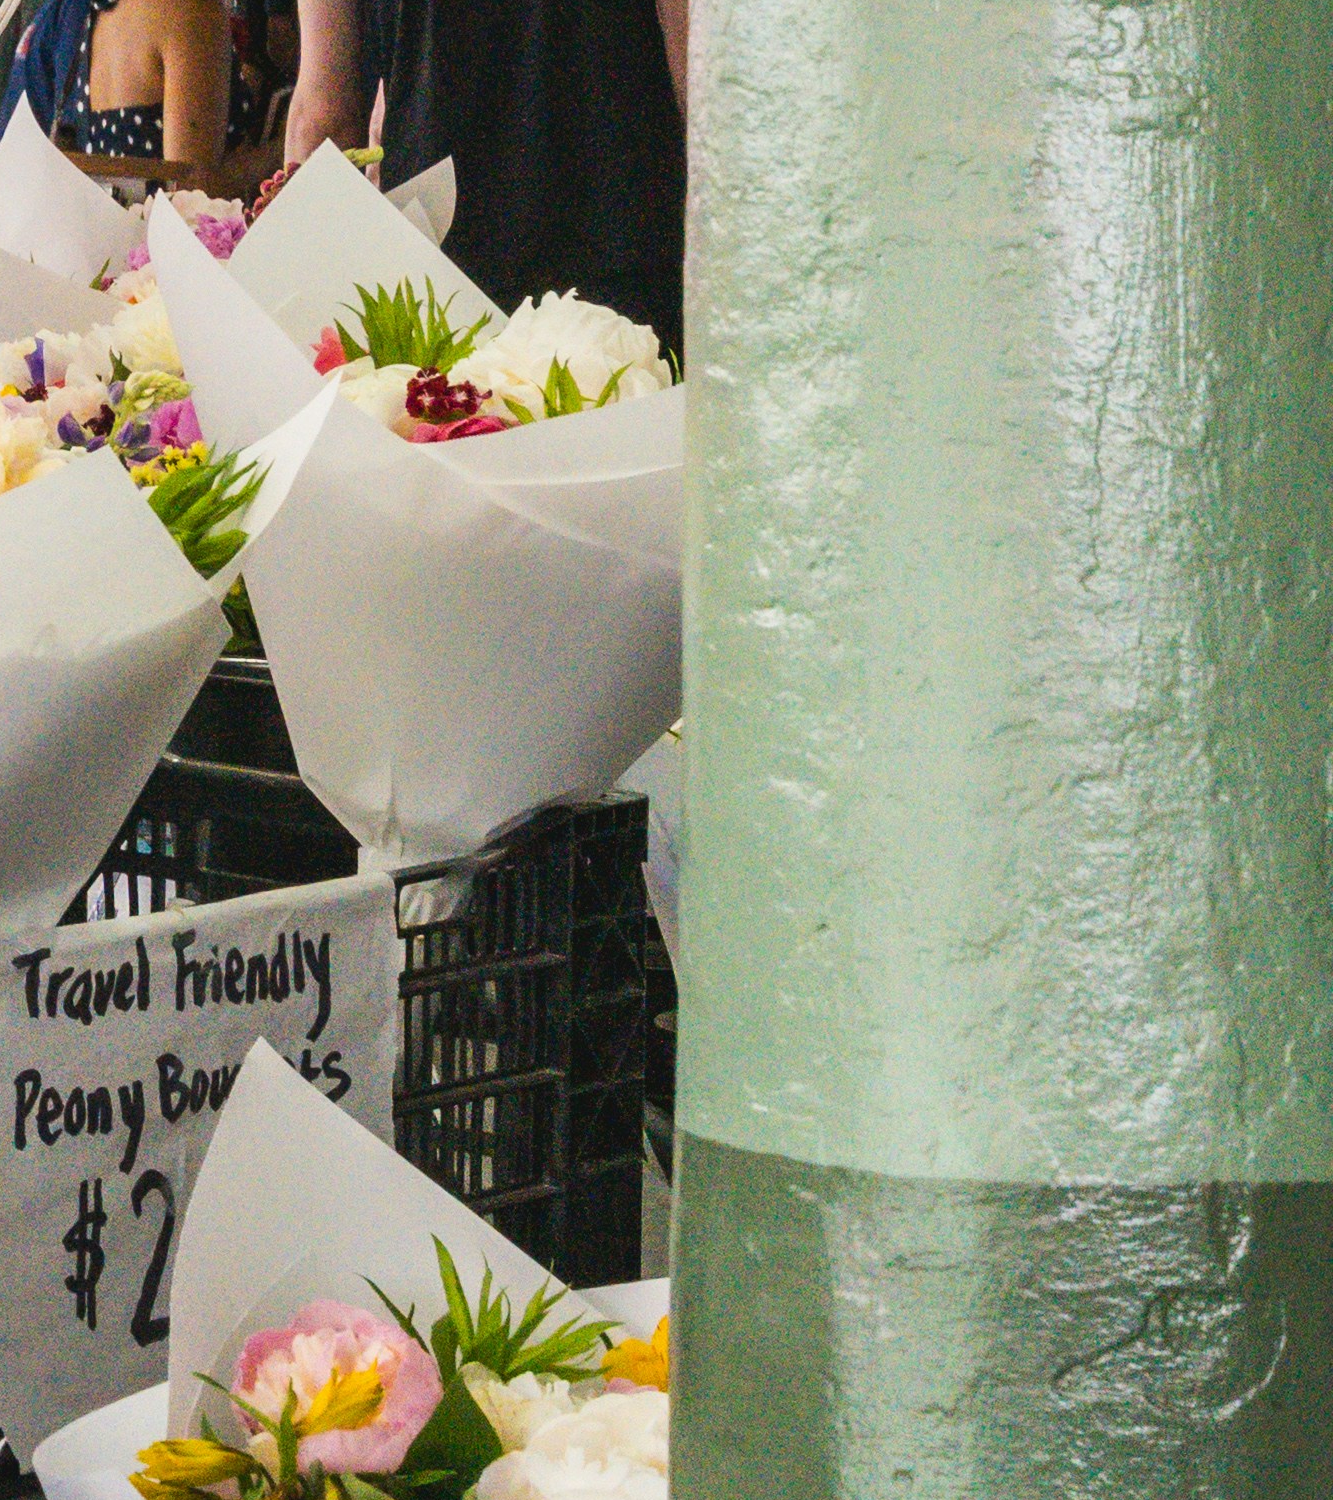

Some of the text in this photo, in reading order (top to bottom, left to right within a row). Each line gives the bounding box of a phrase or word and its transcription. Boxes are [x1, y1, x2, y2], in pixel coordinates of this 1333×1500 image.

[11, 929, 331, 1042] Travel Friendly
[13, 1068, 145, 1175] Peony
